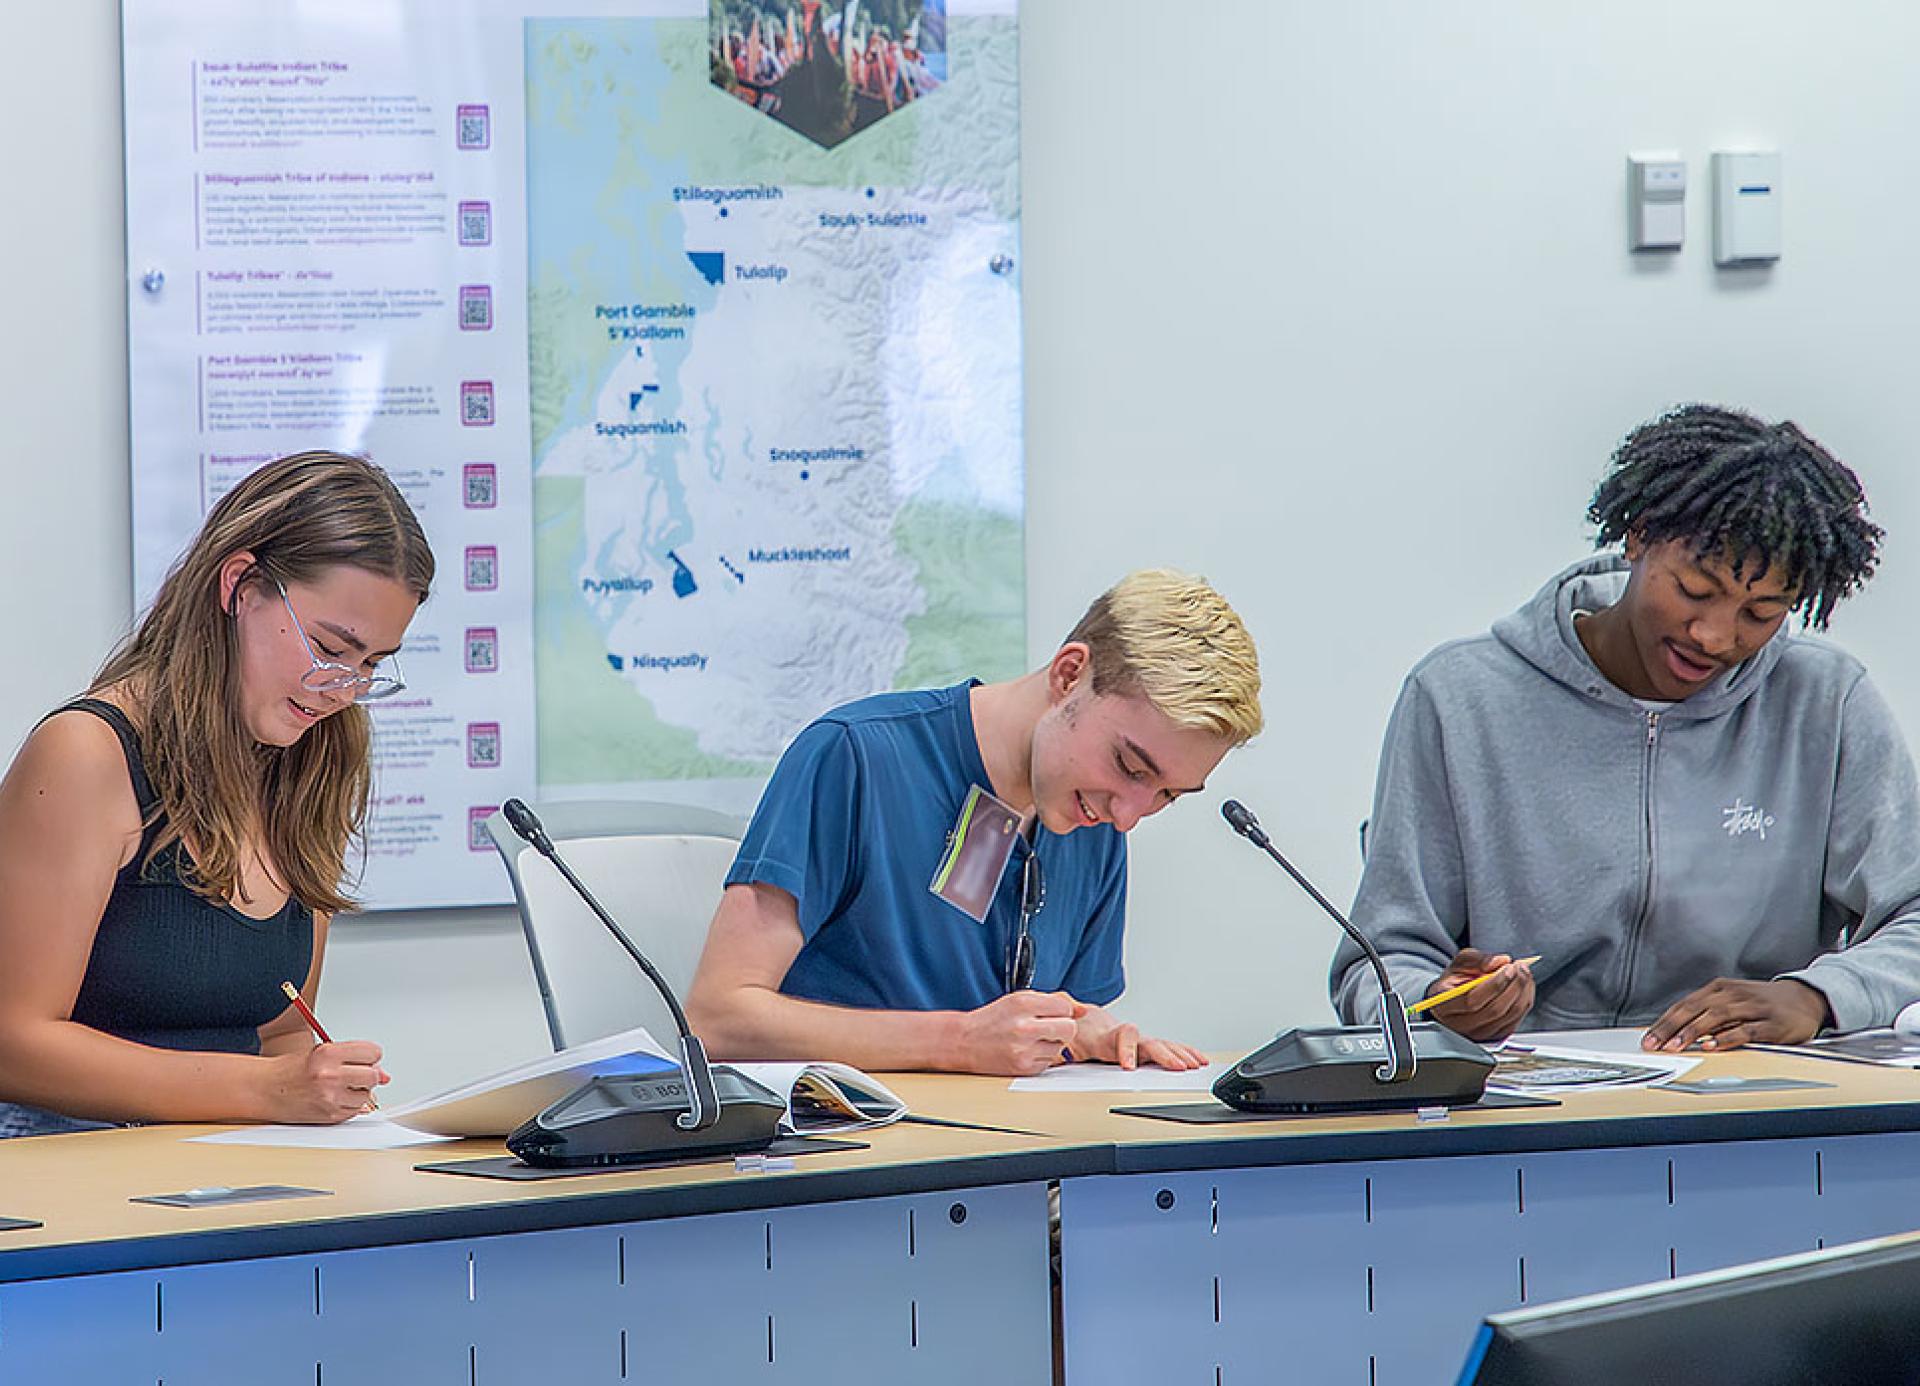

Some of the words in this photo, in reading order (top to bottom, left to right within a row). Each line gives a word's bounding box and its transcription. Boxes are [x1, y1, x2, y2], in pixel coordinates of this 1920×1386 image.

[673, 185, 783, 203] Stillaguamish
[735, 265, 787, 282] Tulalip
[596, 304, 628, 319] Port
[632, 304, 696, 319] Gamble
[596, 420, 686, 439] Suquamish
[633, 653, 708, 671] Nisqually
